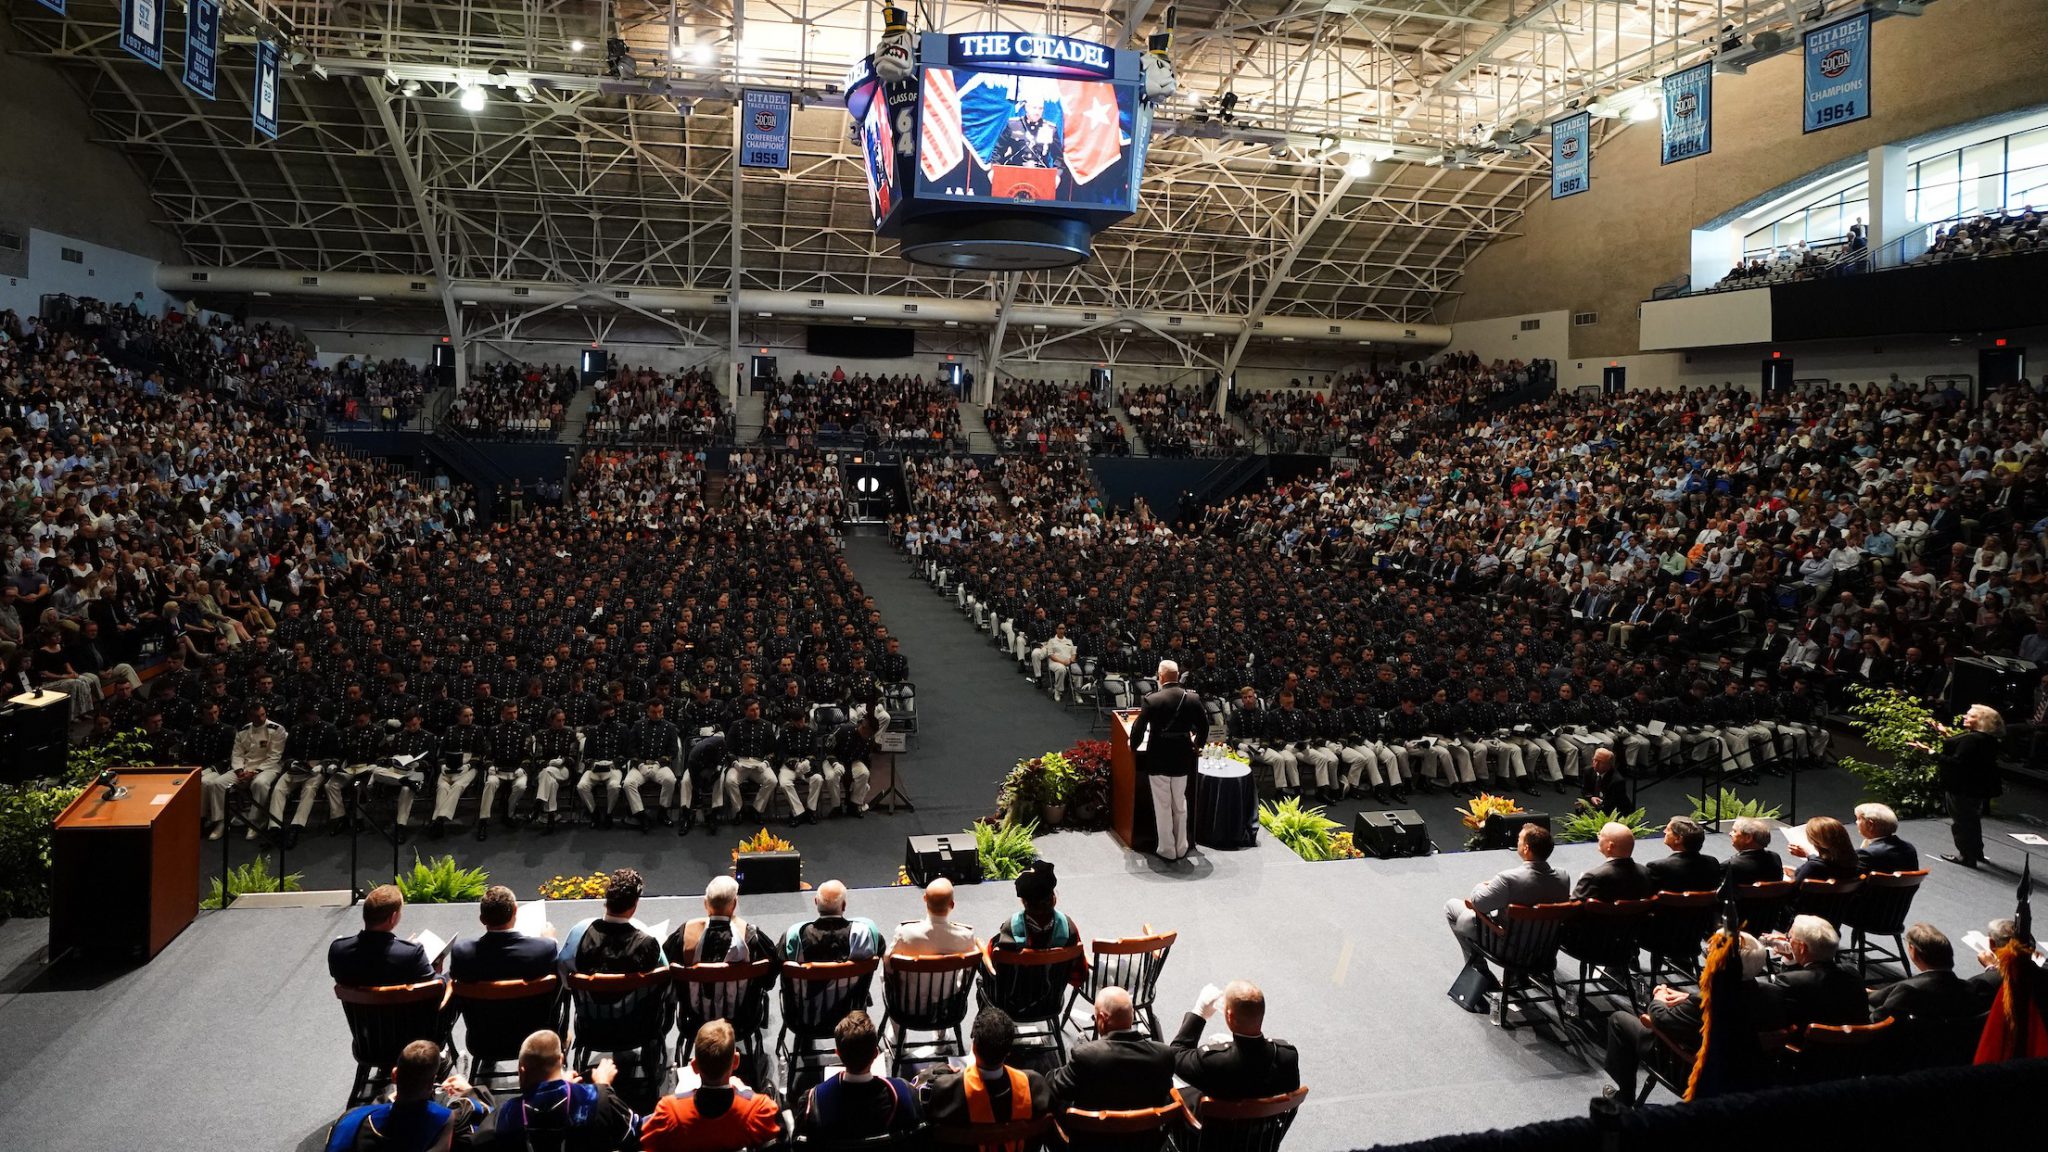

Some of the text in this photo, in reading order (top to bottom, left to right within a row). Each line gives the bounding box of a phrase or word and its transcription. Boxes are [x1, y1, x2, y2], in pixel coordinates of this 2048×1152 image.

[197, 0, 211, 32] C
[197, 31, 208, 45] LES
[1810, 20, 1865, 47] CITADEL
[1840, 32, 1863, 45] GOLF
[959, 35, 1109, 69] THE CITADEL
[1821, 50, 1851, 73] SOCON
[1666, 69, 1707, 90] CITADEL
[747, 93, 787, 104] CITADEL
[889, 92, 918, 105] CLASS OF
[1809, 79, 1863, 102] CHAMPIONS
[1674, 95, 1697, 115] SOCON
[1816, 101, 1855, 124] 1964
[754, 113, 777, 127] SOCON
[1555, 117, 1586, 134] CITADEL
[746, 133, 785, 143] CONFERENCE
[746, 141, 785, 150] CHAMPIONS
[1561, 139, 1579, 156] SOCON
[750, 151, 778, 164] 1959
[1555, 167, 1585, 180] CHAMPIONS
[1559, 177, 1581, 193] 1967
